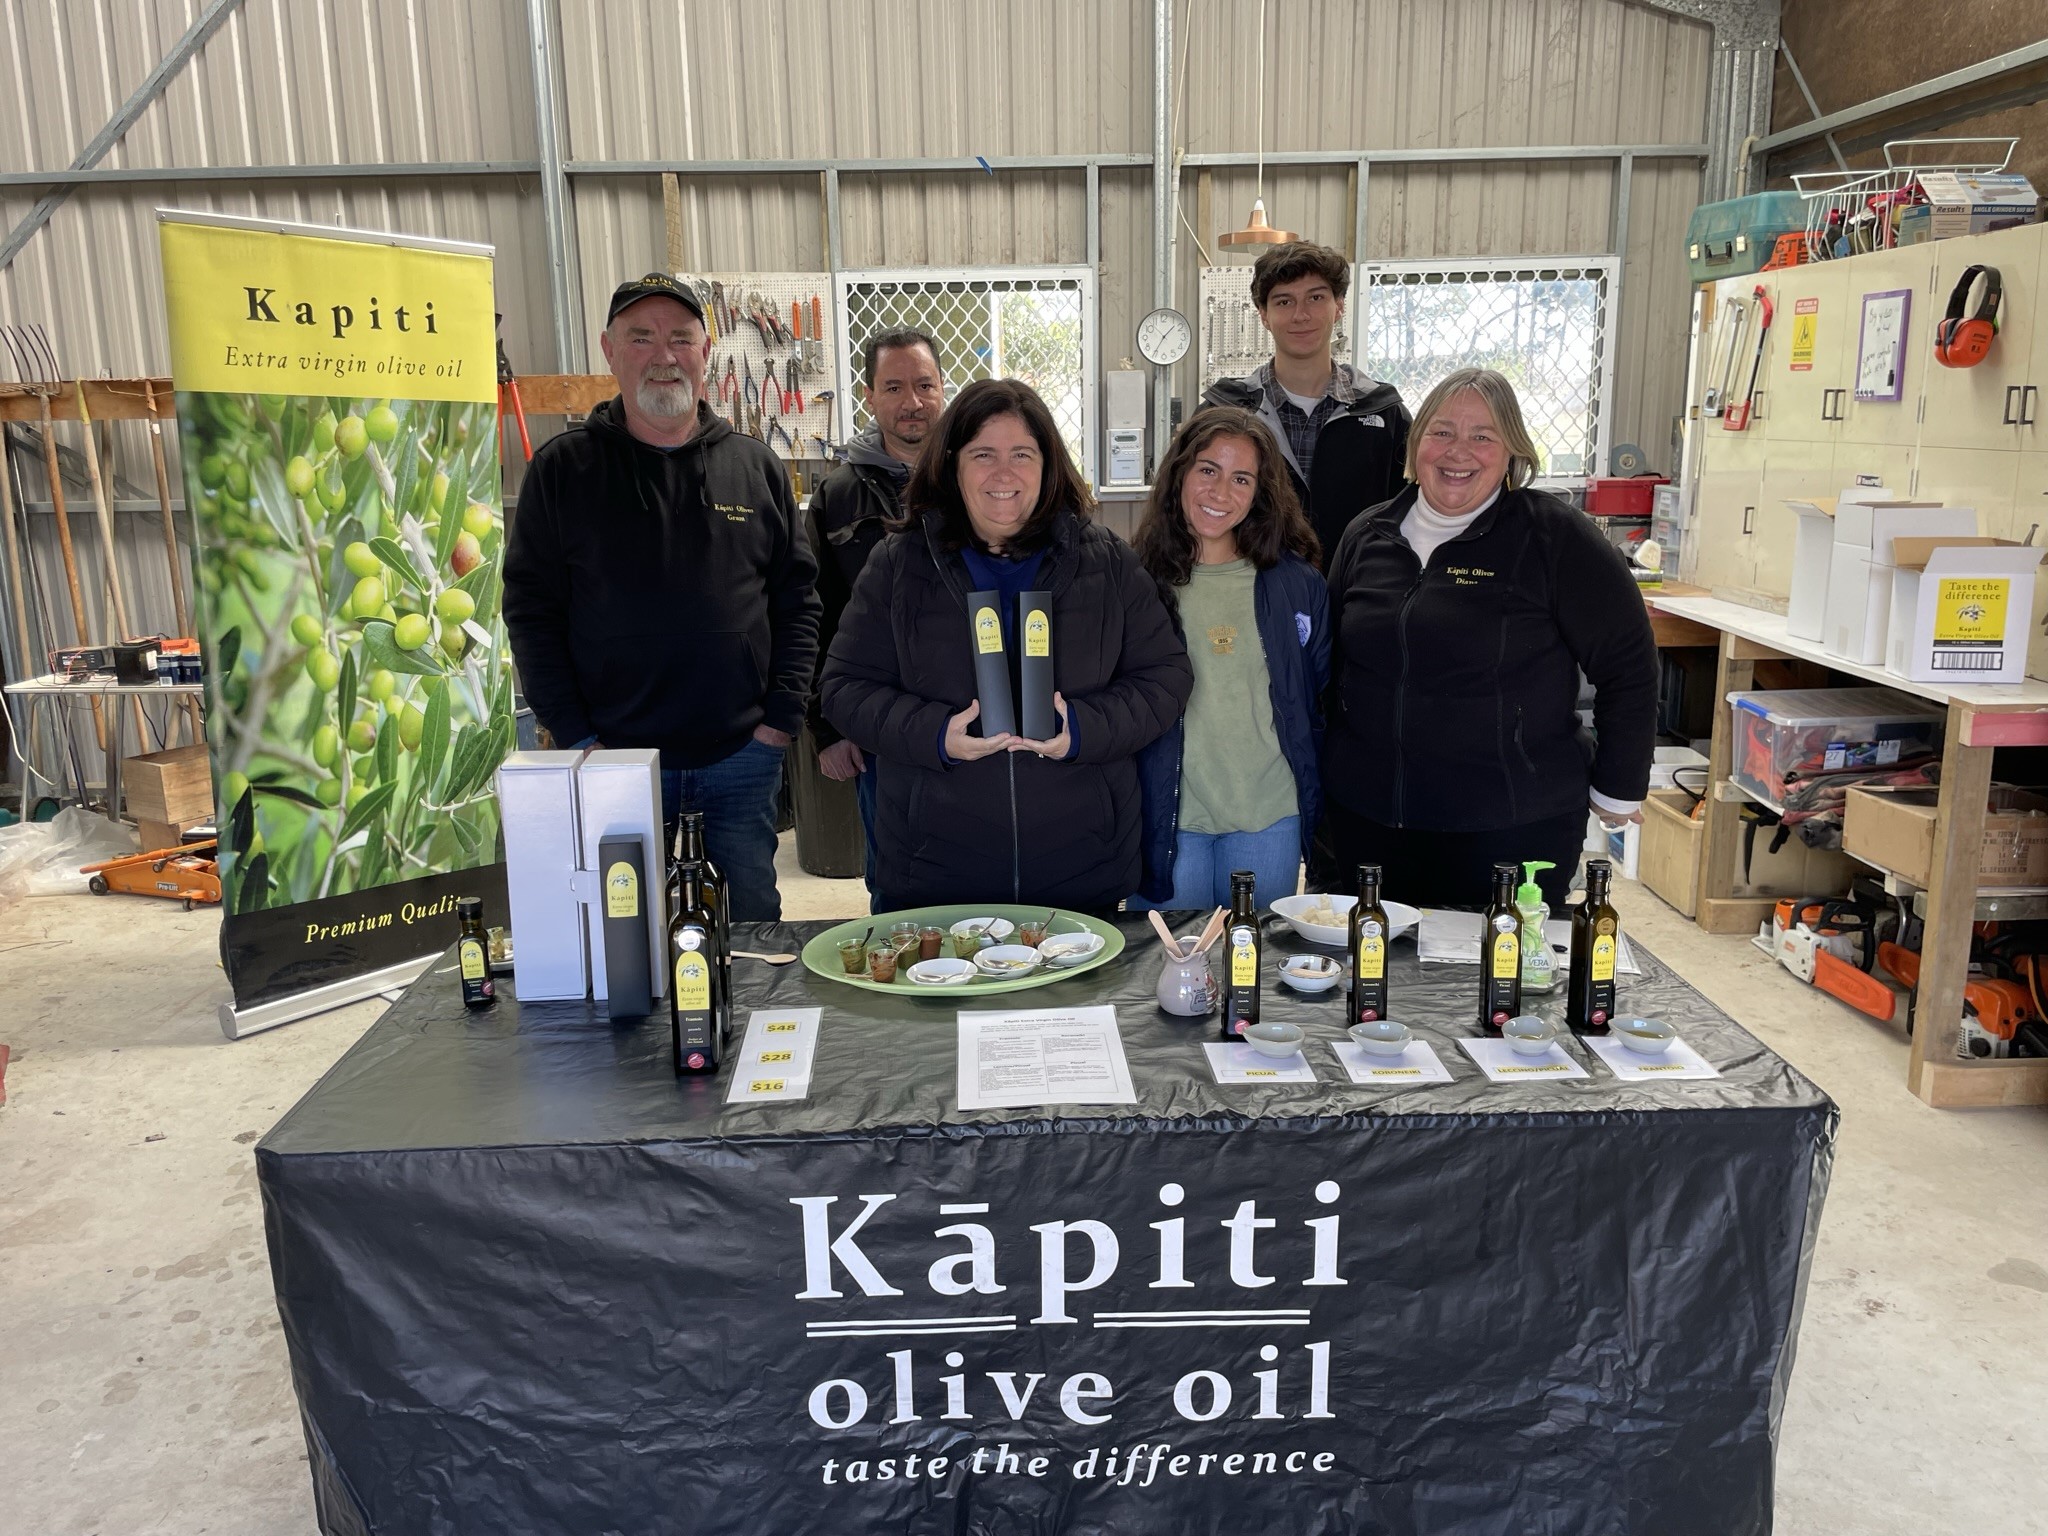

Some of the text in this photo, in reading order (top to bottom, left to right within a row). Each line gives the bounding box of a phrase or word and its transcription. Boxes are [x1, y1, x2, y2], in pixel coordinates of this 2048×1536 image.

[1936, 205, 1965, 213] Results
[243, 286, 438, 339] Kapiti
[1160, 313, 1168, 323] 12
[1145, 324, 1154, 333] 10
[1177, 322, 1184, 332] 2
[1180, 332, 1186, 341] 3
[1145, 342, 1151, 351] 8
[1161, 352, 1168, 360] 6
[1170, 349, 1177, 358] 5
[224, 346, 463, 378] Extra virgin olive oil
[736, 505, 754, 514] Olives
[1472, 568, 1495, 577] Olives
[1949, 581, 2000, 591] Taste the
[1945, 591, 2001, 600] difference
[304, 894, 461, 943] Premium Qualit
[1528, 959, 1549, 967] VERA
[767, 1024, 796, 1032] $48
[761, 1053, 791, 1062] $28
[751, 1082, 783, 1091] $16
[789, 1180, 1348, 1324] Kāpiti
[807, 1340, 1336, 1430] olive oil
[821, 1443, 1336, 1487] taste the difference
